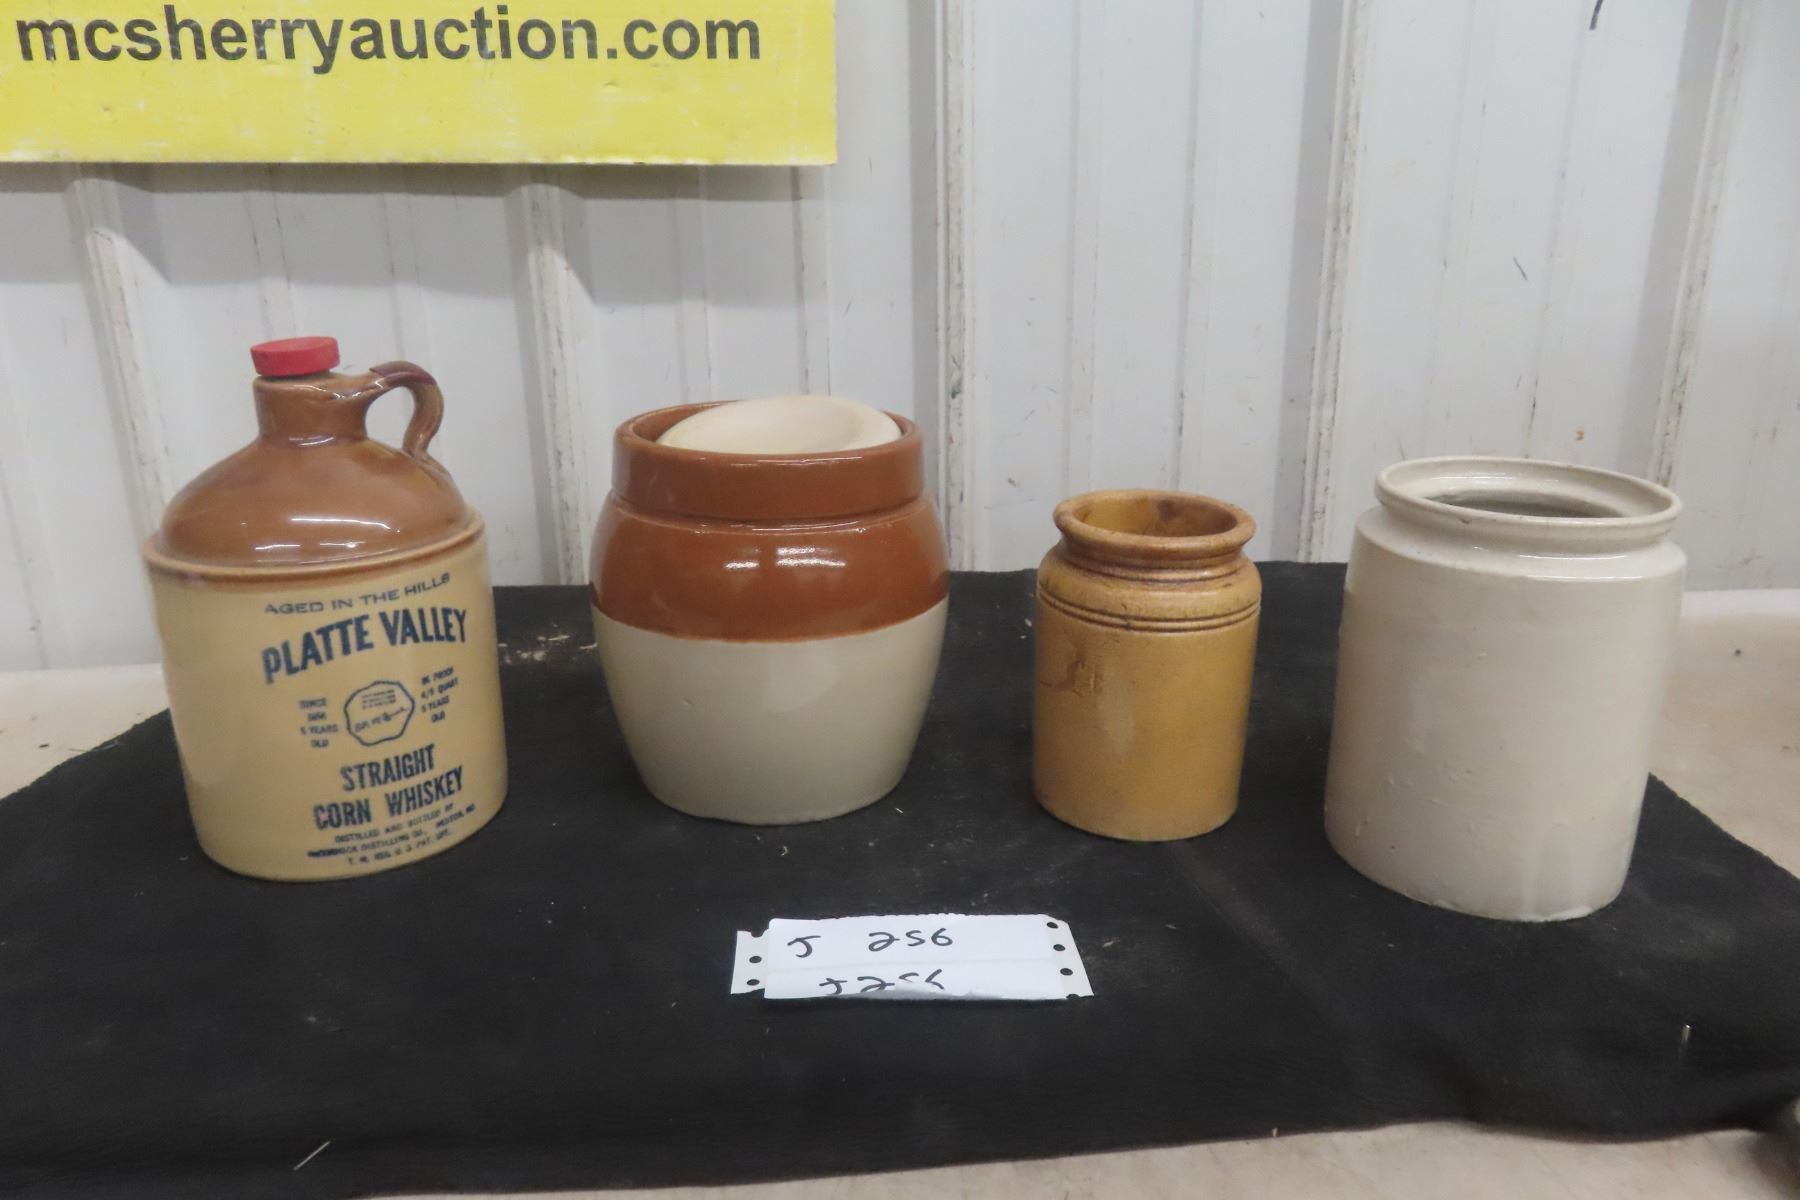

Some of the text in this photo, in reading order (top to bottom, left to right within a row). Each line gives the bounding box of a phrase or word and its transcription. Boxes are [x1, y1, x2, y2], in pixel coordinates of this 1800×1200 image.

[17, 5, 761, 73] mcsherryauction.com
[265, 572, 450, 614] AGED IN THE HILLS
[262, 607, 466, 684] PLATTE VALLEY
[340, 743, 435, 791] STRAIGHT
[313, 765, 462, 830] CORN WHISKEY
[335, 830, 380, 843] DISTILLED
[868, 928, 953, 952] 256
